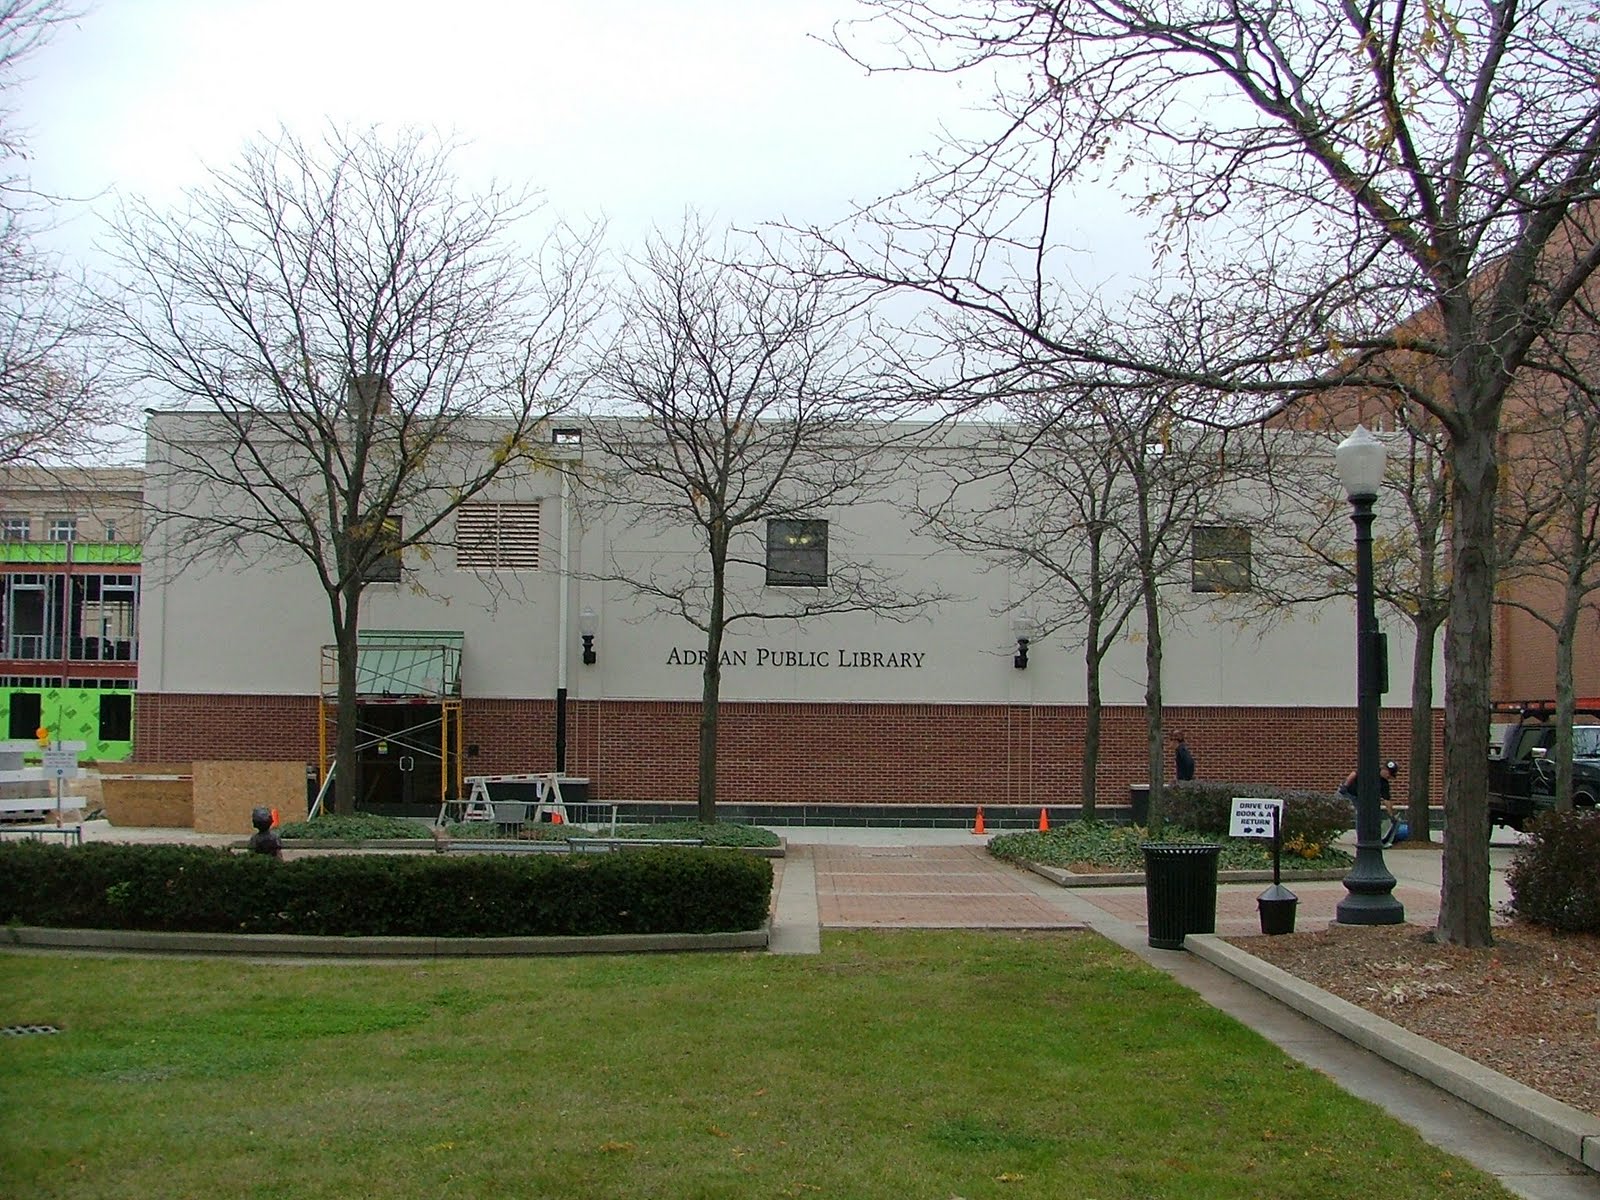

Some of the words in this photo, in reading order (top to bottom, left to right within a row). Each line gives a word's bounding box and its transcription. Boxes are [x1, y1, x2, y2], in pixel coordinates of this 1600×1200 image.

[666, 647, 747, 666] ADRAN
[757, 648, 829, 667] PUBLIC
[838, 649, 926, 668] LIBRARY
